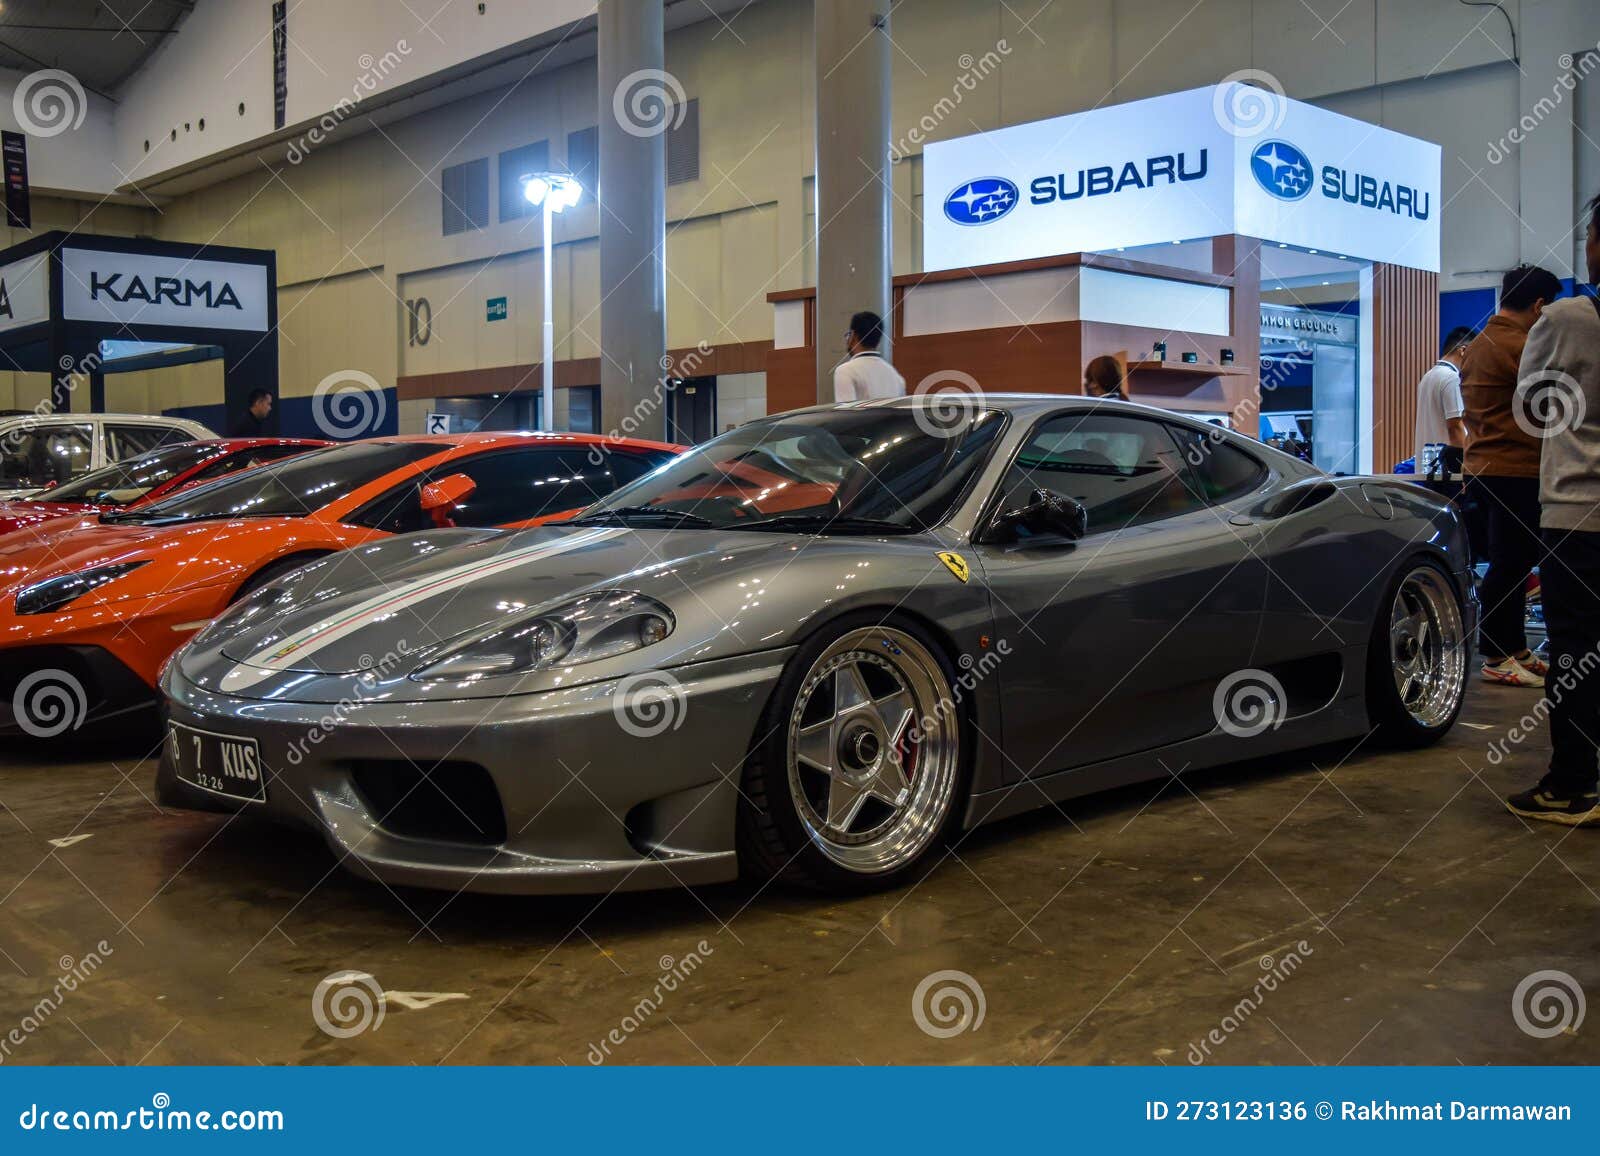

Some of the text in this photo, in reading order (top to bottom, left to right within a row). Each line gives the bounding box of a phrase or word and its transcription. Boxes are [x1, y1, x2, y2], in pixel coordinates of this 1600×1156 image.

[1030, 149, 1208, 205] SUBARU
[1322, 166, 1429, 220] SUBARU
[90, 271, 243, 310] KARMA
[406, 297, 432, 348] 10
[193, 735, 202, 769] 7
[220, 741, 258, 781] KUS
